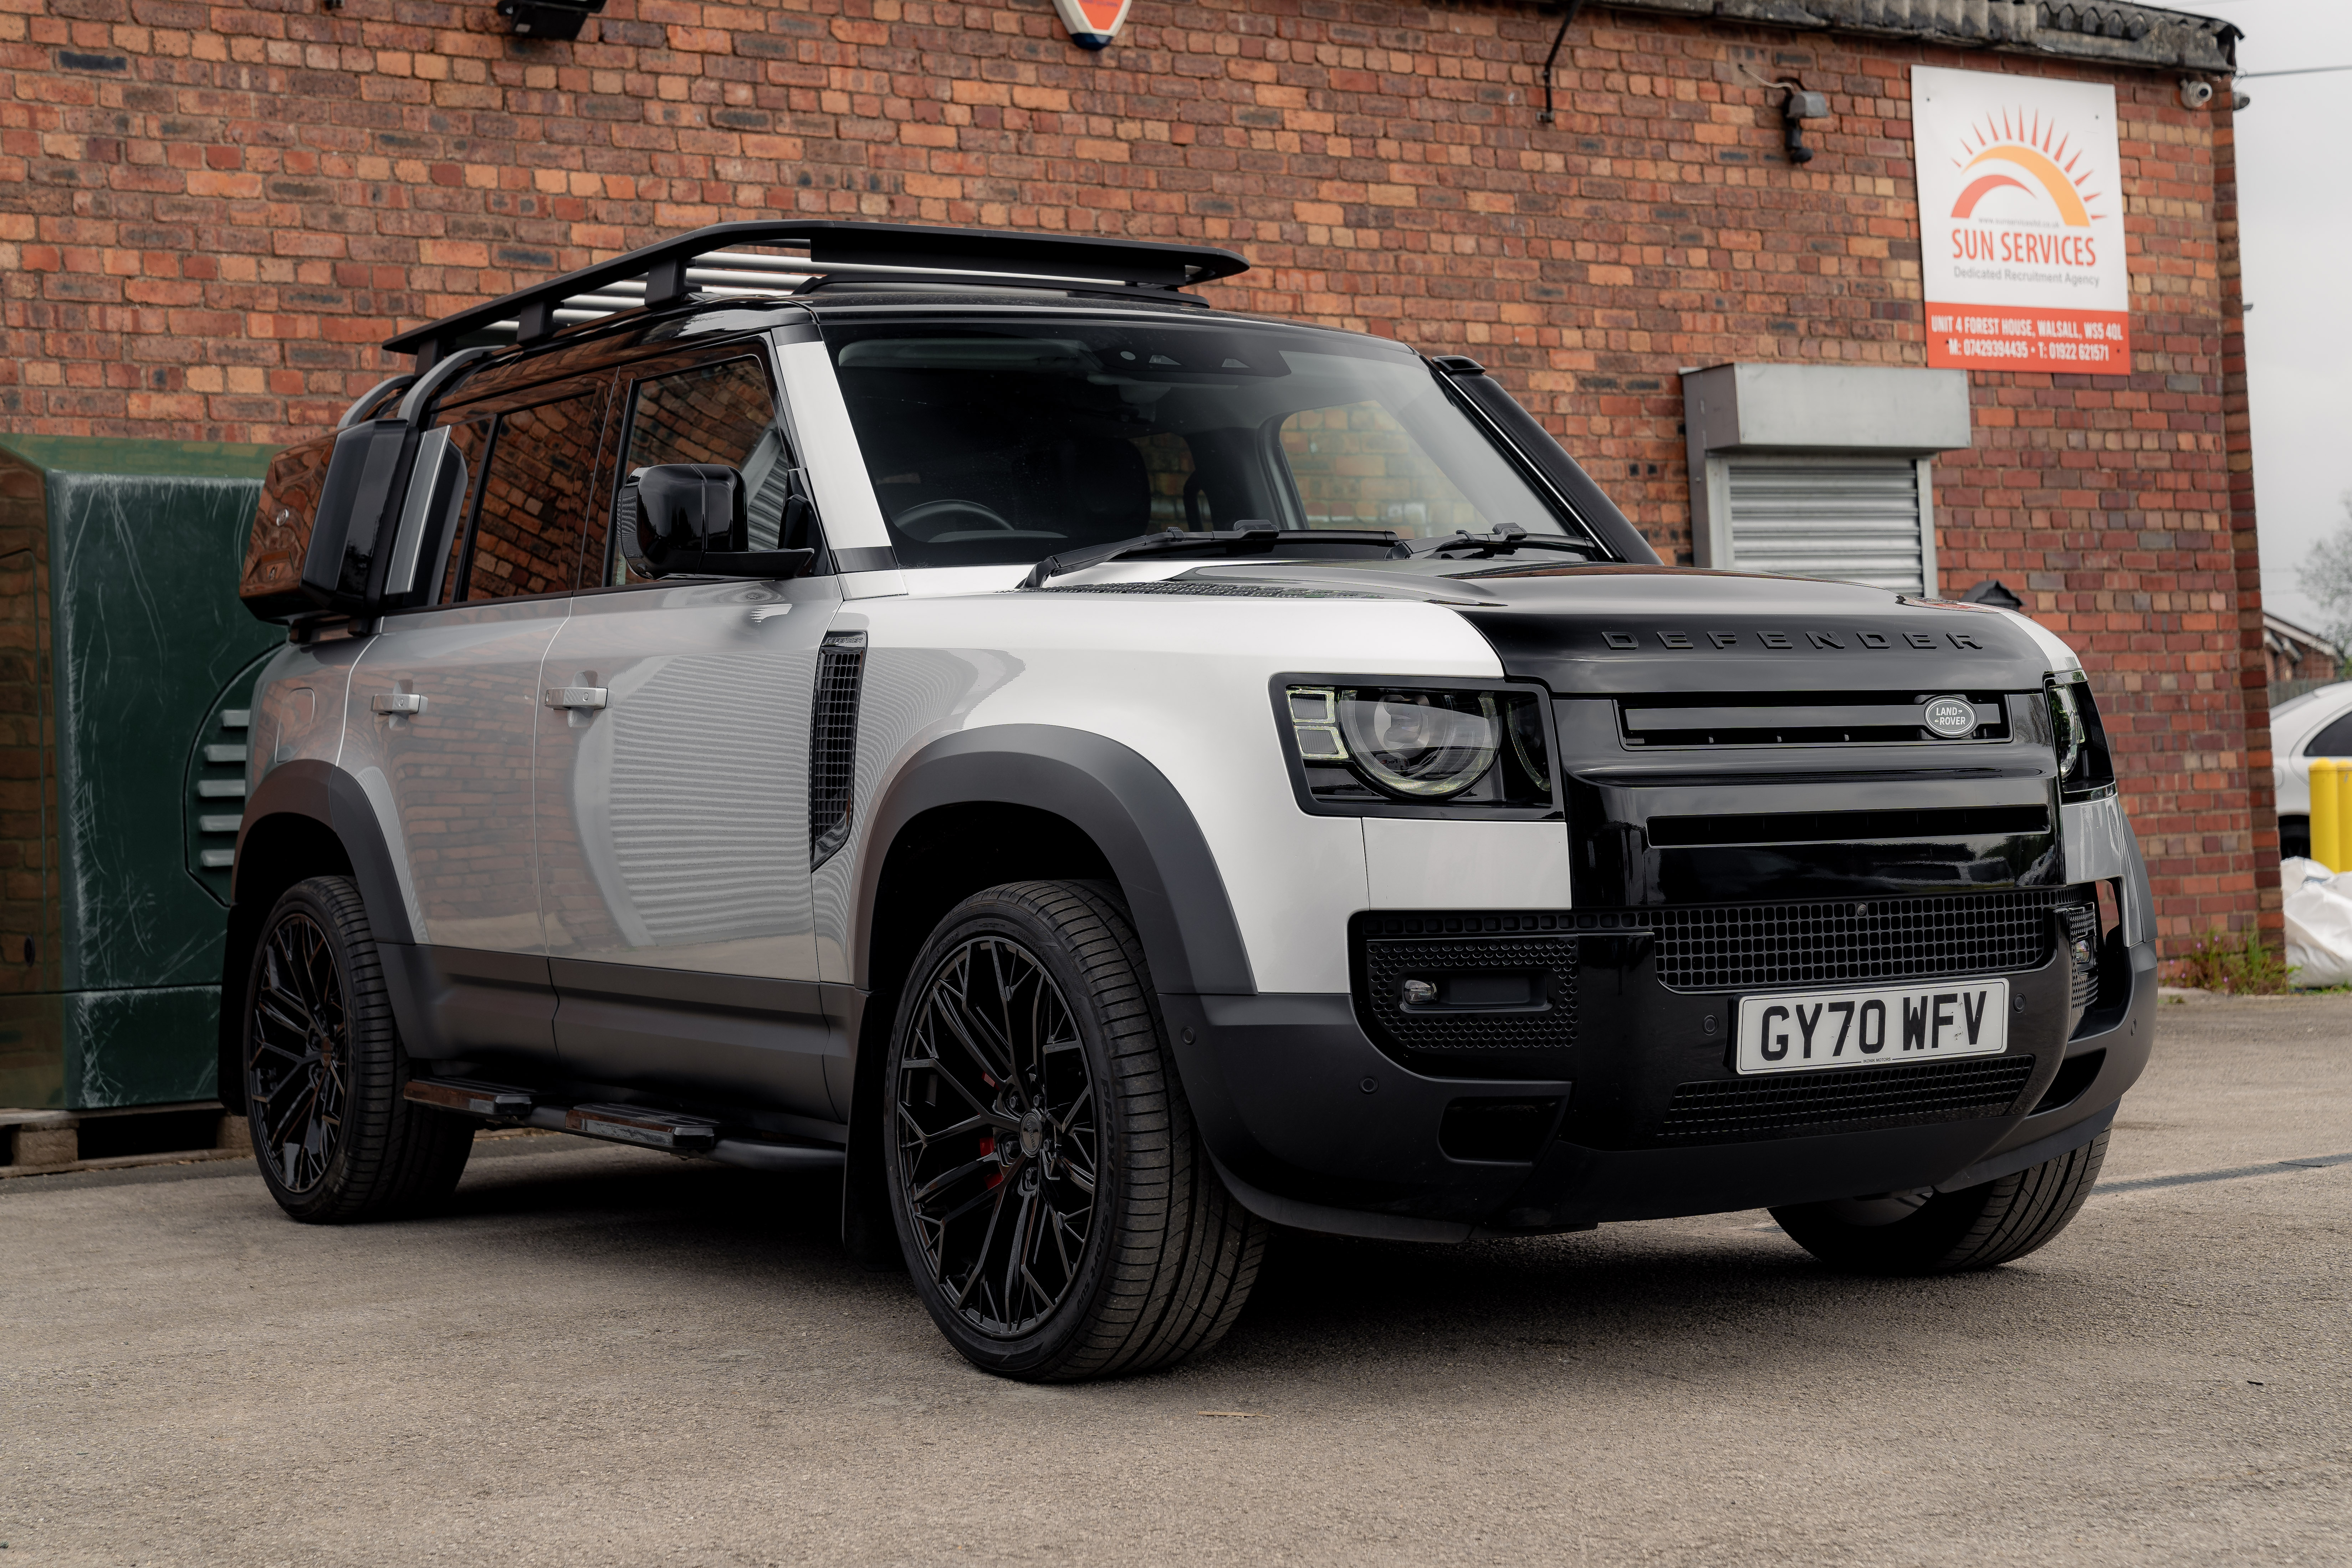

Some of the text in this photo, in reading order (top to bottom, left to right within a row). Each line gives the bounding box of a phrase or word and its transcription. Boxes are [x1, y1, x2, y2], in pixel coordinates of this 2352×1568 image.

[1952, 229, 2096, 266] SUN SERVICES
[1954, 265, 2100, 288] Dedicated Recruitment Agency
[1931, 315, 1954, 333] UNIT
[1955, 316, 1963, 334] 4
[1964, 316, 2000, 335] FOREST
[2001, 318, 2036, 338] HOUSE,
[2037, 320, 2083, 340] WALSALL,
[2083, 322, 2105, 340] WS5
[1949, 338, 1962, 356] M:
[2037, 341, 2047, 359] T:
[1601, 631, 1983, 650] DEFENDER
[1936, 707, 1957, 716] LAND
[1939, 716, 1966, 725] ROVER
[1760, 990, 1987, 1062] GY70 WFV
[1101, 1077, 1115, 1208] PROXES
[1077, 1278, 1090, 1311] SUV
